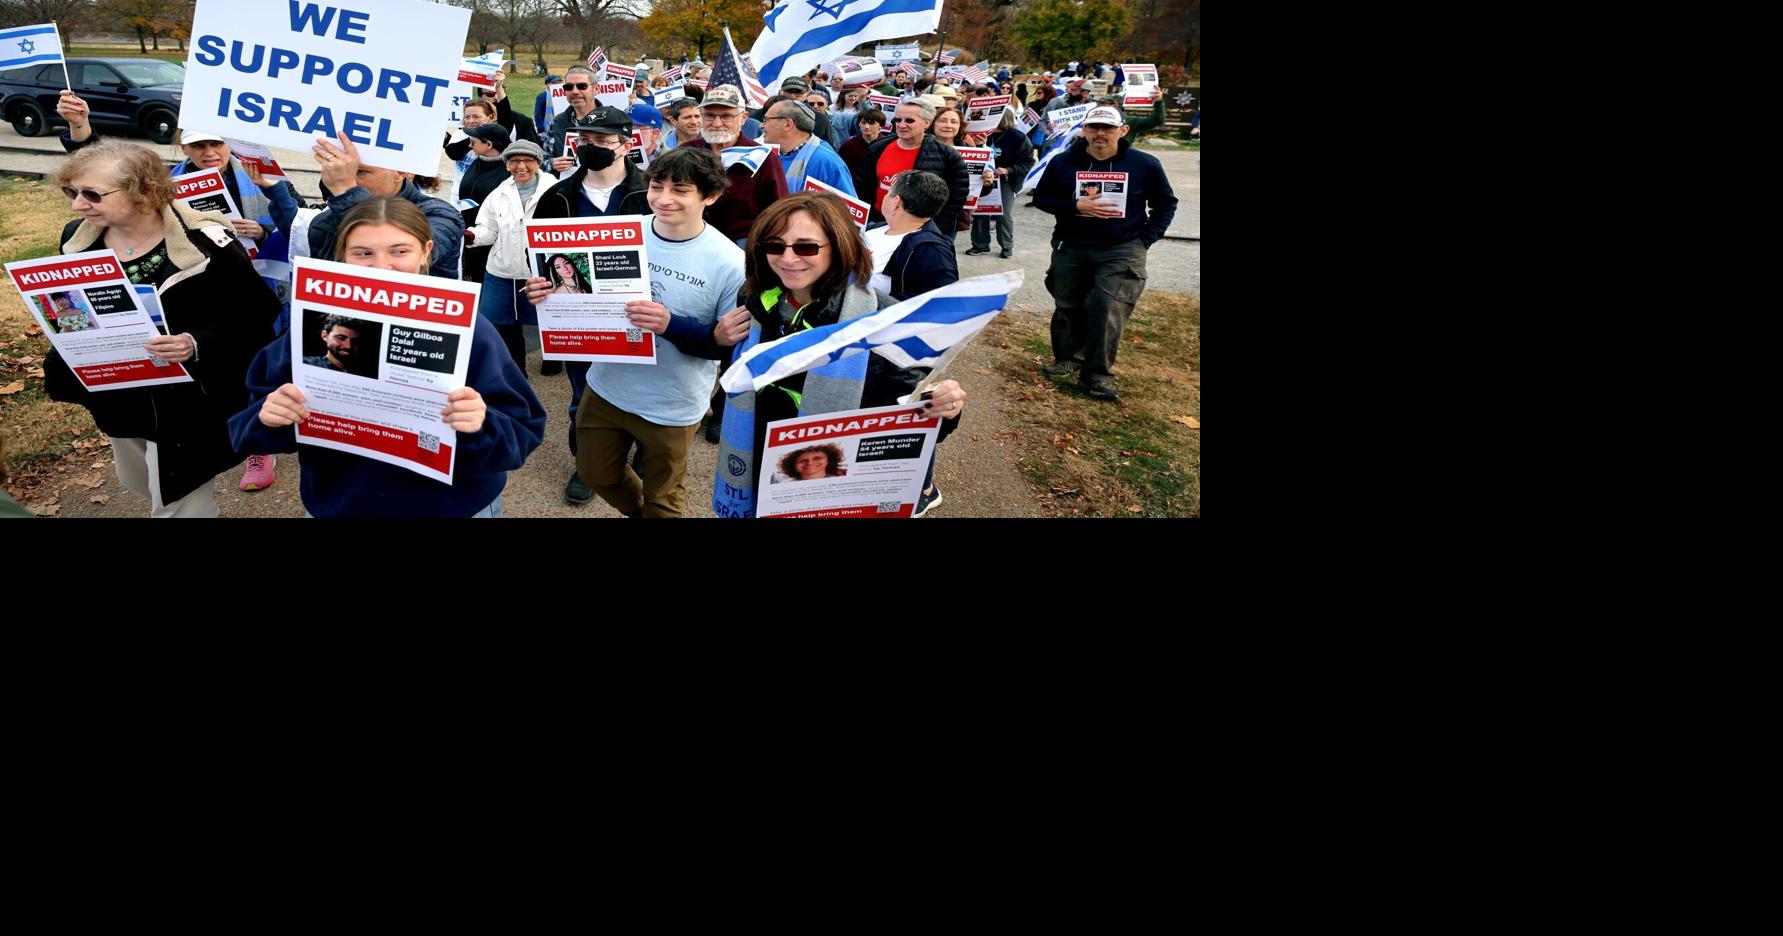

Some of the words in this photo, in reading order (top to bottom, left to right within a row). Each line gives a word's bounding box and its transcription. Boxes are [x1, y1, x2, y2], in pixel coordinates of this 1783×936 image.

[288, 0, 371, 45] WE
[194, 34, 450, 109] SUPPORT
[1064, 106, 1087, 115] STAND
[216, 87, 405, 152] ISRAEL
[1078, 172, 1125, 180] KIDNAPPED
[532, 228, 637, 243] KIDNAPPED
[20, 263, 116, 285] KIDNAPPED
[305, 277, 464, 317] KIDNAPPED
[391, 336, 415, 346] Dalal
[392, 328, 412, 338] Guy
[413, 331, 443, 342] Gilboa
[389, 353, 417, 364] Israeli
[390, 344, 402, 352] 22
[402, 348, 428, 357] years
[429, 352, 445, 360] old
[307, 422, 333, 432] home
[333, 428, 356, 438] alive.
[308, 415, 335, 426] Please
[337, 421, 357, 431] help
[357, 425, 381, 437] bring
[381, 431, 404, 441] them
[724, 483, 749, 500] STL
